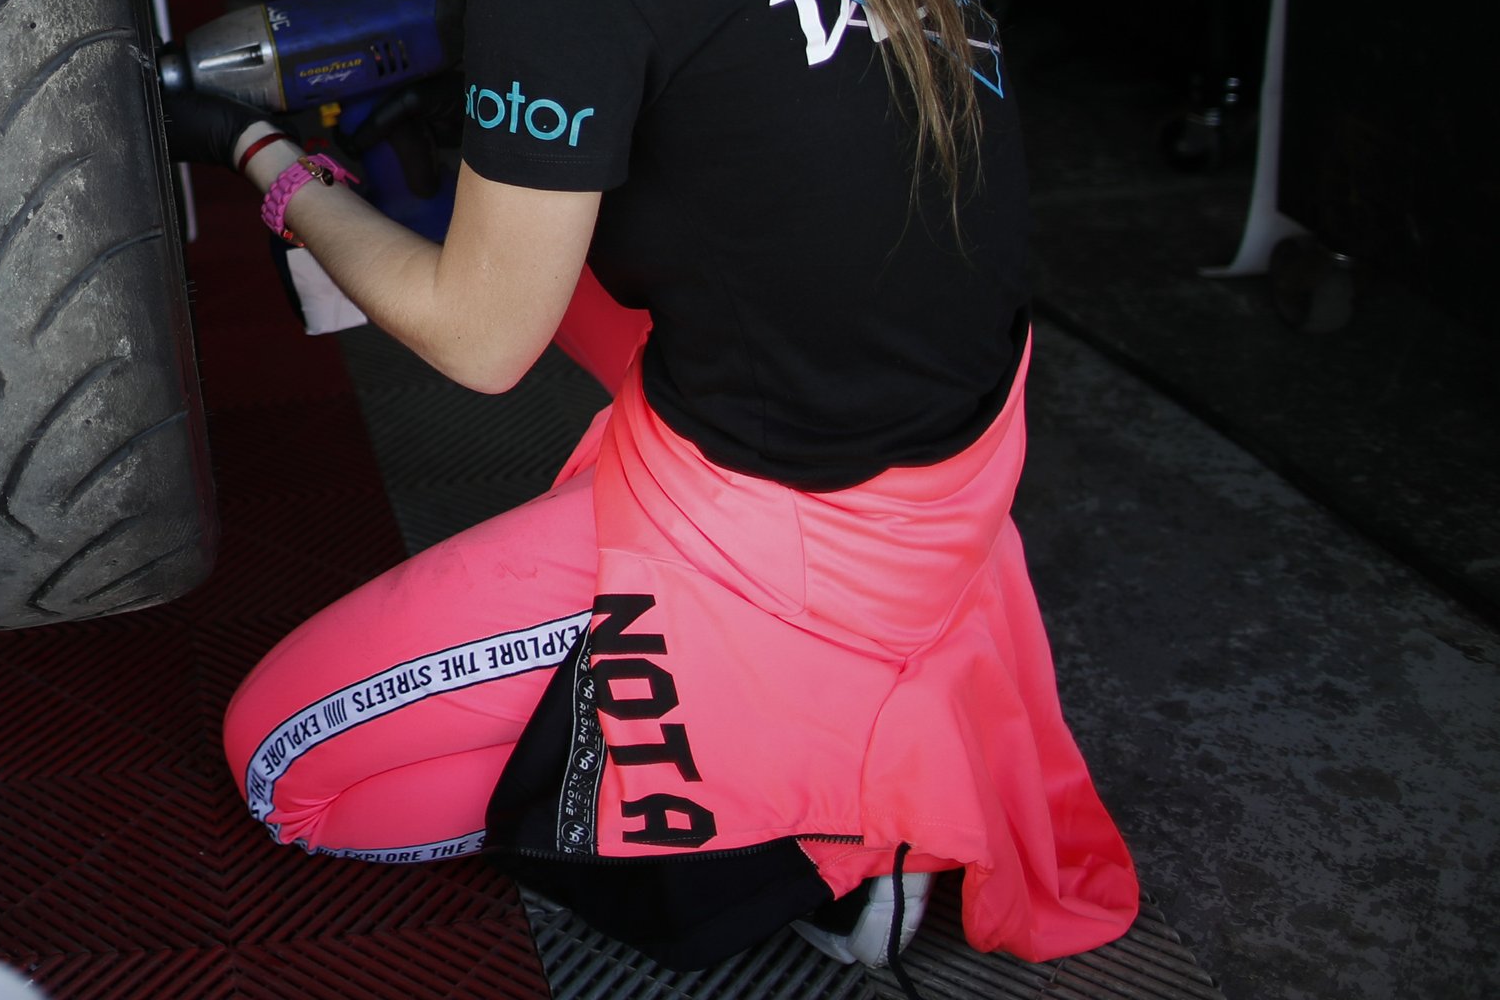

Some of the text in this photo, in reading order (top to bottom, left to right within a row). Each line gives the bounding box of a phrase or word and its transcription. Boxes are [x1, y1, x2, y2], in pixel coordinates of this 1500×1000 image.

[438, 652, 481, 682] THE
[485, 625, 581, 669] EXPLORE
[351, 664, 433, 713] STREETS
[261, 713, 322, 776] EXPLORE
[342, 850, 423, 863] EXPLORE
[430, 839, 469, 859] THE
